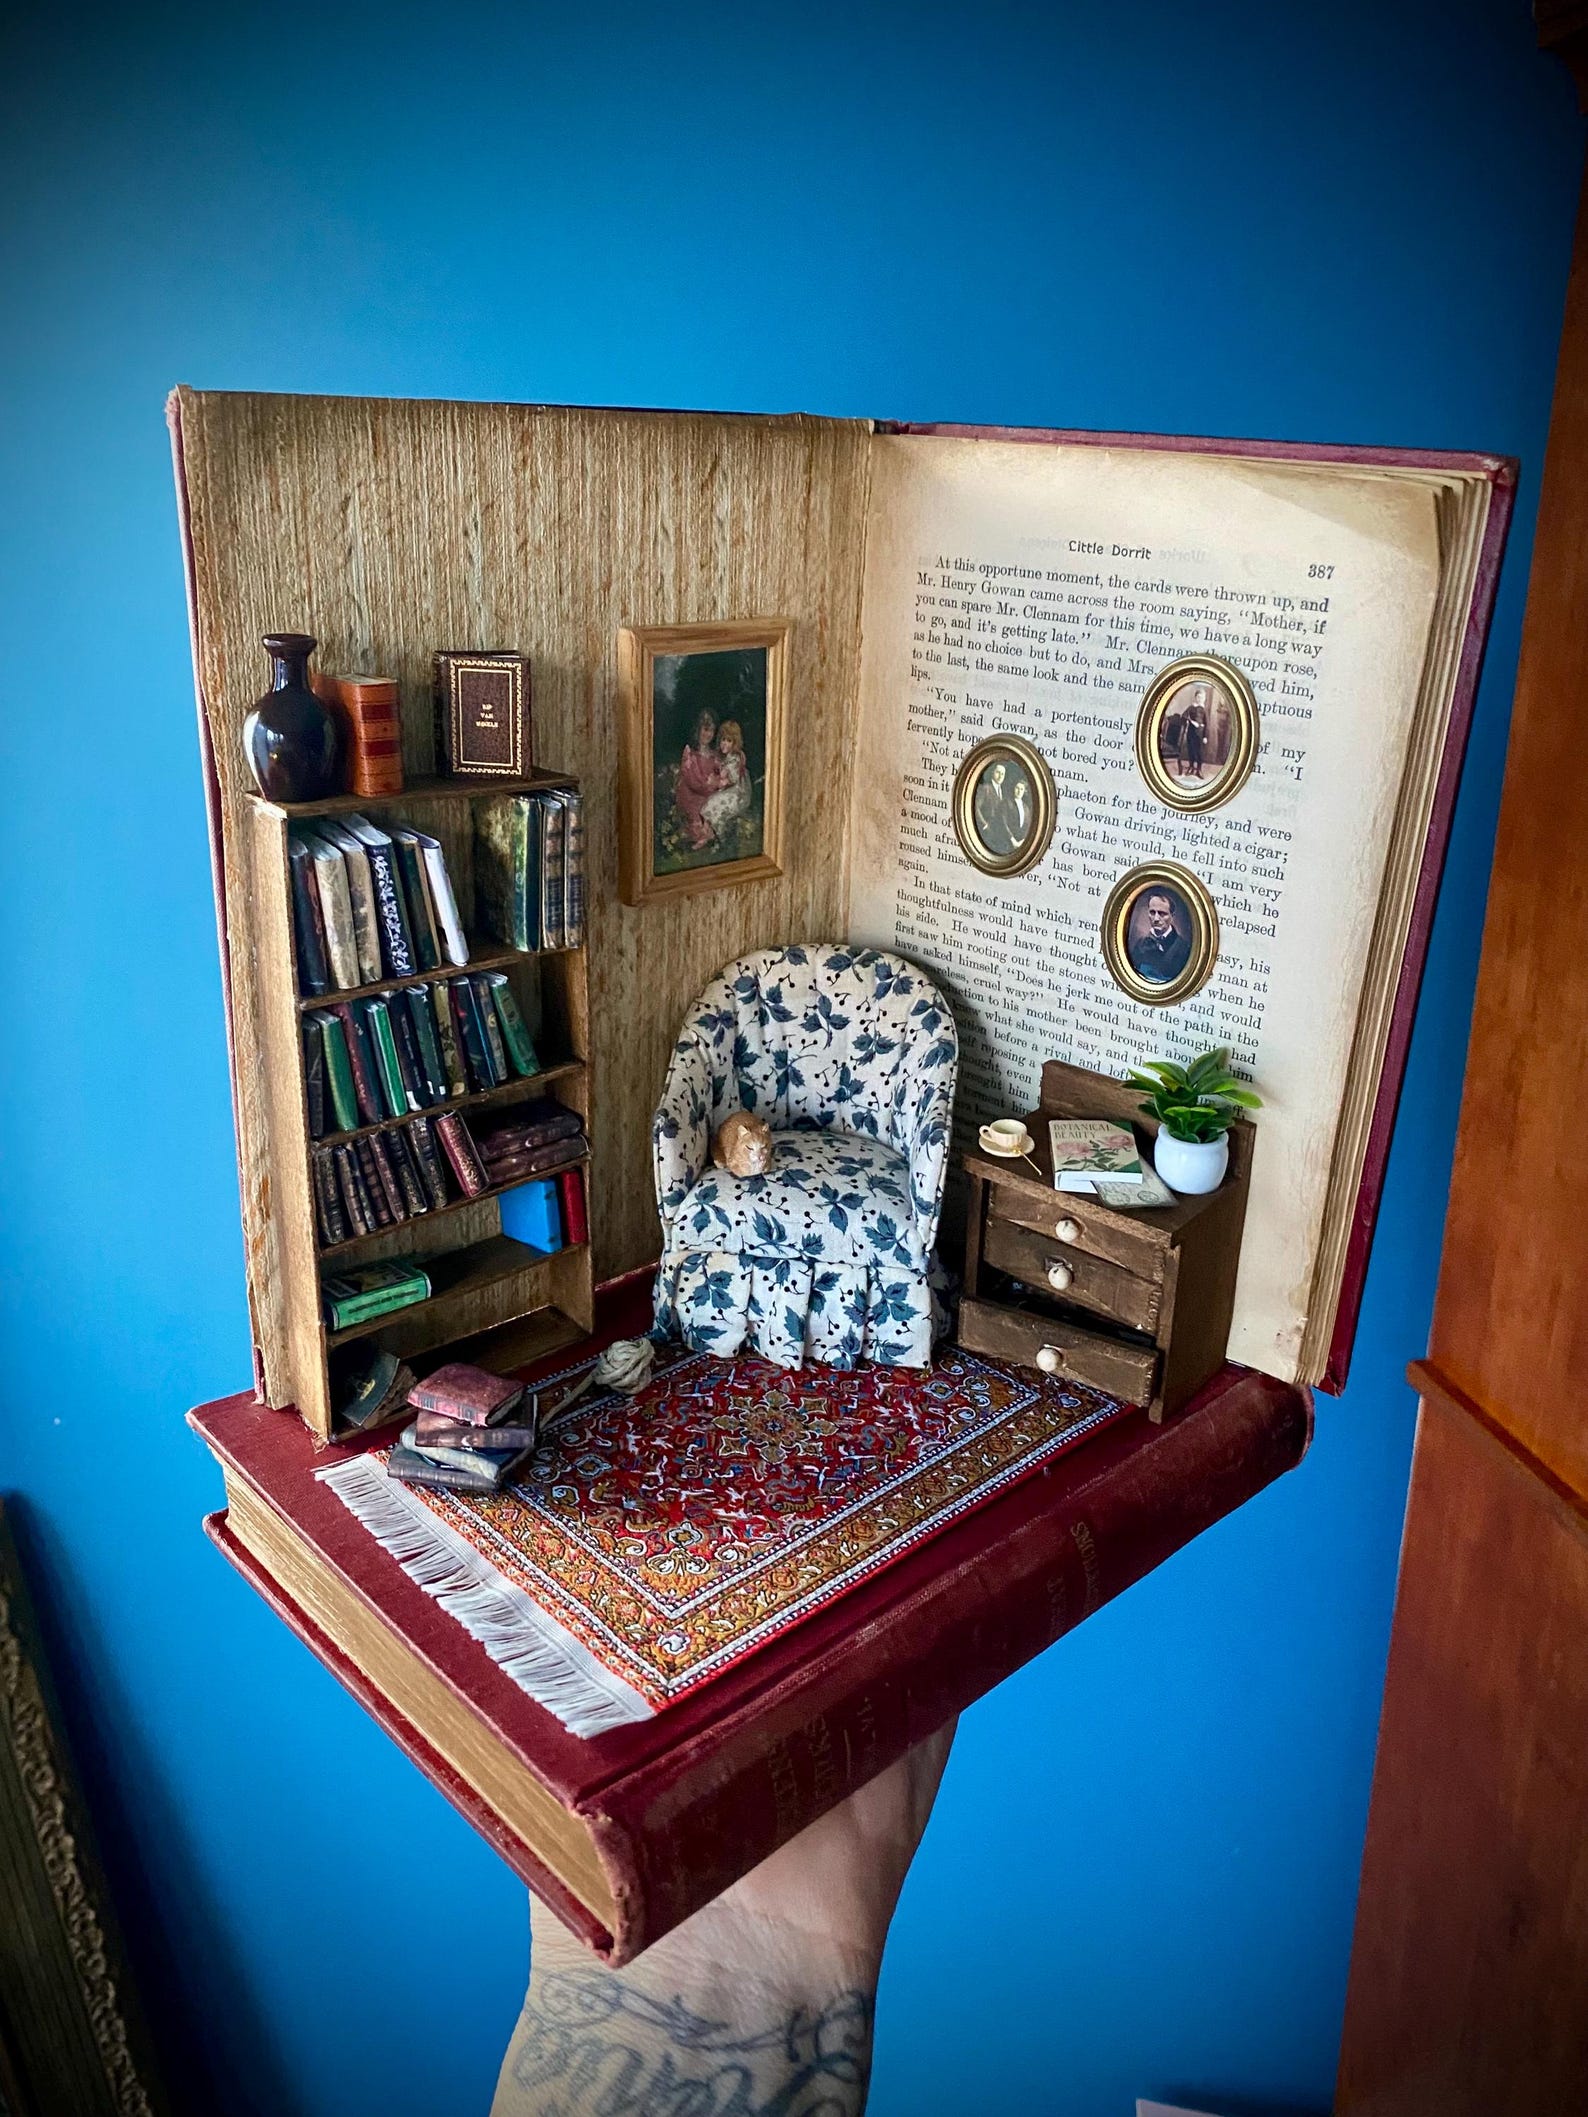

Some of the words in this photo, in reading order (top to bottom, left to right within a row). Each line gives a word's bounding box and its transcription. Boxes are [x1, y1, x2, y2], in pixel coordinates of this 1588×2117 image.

[1068, 540, 1103, 554] Little
[1111, 543, 1151, 560] Dorrit
[1307, 563, 1334, 579] 387
[917, 571, 935, 587] Mr.
[940, 574, 976, 595] Henry
[981, 579, 1025, 597] Gowan
[1029, 590, 1063, 602] came
[1067, 594, 1108, 607] across
[1113, 595, 1134, 610] the
[1139, 602, 1174, 618] room
[1179, 605, 1230, 625] saying,
[954, 557, 975, 572] this
[978, 564, 1041, 579] opportune
[1046, 571, 1103, 589] moment,
[1108, 574, 1129, 589] the
[1134, 579, 1171, 594] cards
[1175, 585, 1208, 598] were
[1214, 585, 1265, 605] thrown
[1299, 597, 1329, 612] and
[915, 594, 935, 606] you
[938, 597, 957, 608] can
[960, 600, 991, 614] spare
[995, 600, 1018, 617] Mr.
[1022, 604, 1079, 624] Clennam
[1084, 612, 1104, 627] for
[1109, 615, 1135, 631] this
[1139, 619, 1173, 639] time,
[1203, 626, 1239, 644] have
[1254, 632, 1287, 654] long
[1291, 642, 1322, 658] way
[950, 616, 971, 630] and
[1001, 624, 1047, 643] getting
[1104, 634, 1128, 651] Mr.
[1283, 662, 1317, 679] rose,
[910, 664, 930, 681] lips.
[925, 649, 941, 663] the
[946, 651, 969, 670] last,
[975, 657, 993, 671] the
[997, 664, 1029, 677] same
[1032, 664, 1059, 681] look
[1063, 672, 1087, 685] and
[1093, 674, 1113, 689] the
[1117, 681, 1146, 694] sam
[943, 632, 963, 648] had
[984, 639, 1022, 656] choice
[1029, 644, 1050, 660] but
[1096, 656, 1121, 670] and
[1126, 659, 1158, 676] Mrs.
[1280, 679, 1313, 700] him,
[960, 712, 983, 726] said
[991, 716, 1038, 737] Gowan,
[1065, 729, 1086, 744] the
[1093, 733, 1123, 749] door
[965, 692, 993, 709] have
[1002, 699, 1025, 715] had
[1050, 710, 1133, 735] portentously
[906, 718, 954, 742] fervently
[1037, 742, 1058, 758] not
[1062, 746, 1096, 765] bored
[1100, 754, 1135, 775] you?
[903, 774, 924, 786] soon
[1074, 806, 1119, 826] Gowan
[1124, 816, 1176, 841] driving,
[1181, 827, 1230, 849] lighted
[1244, 841, 1287, 864] cigar;
[921, 756, 948, 776] They
[1056, 784, 1107, 804] phaeton
[1111, 794, 1131, 809] for
[1136, 799, 1156, 814] the
[1224, 819, 1251, 833] and
[1257, 825, 1291, 841] were
[902, 787, 947, 809] Clennam
[1066, 825, 1097, 841] what
[1122, 838, 1165, 858] would,
[1191, 850, 1214, 865] fell
[1218, 855, 1246, 872] into
[1251, 865, 1284, 880] such
[910, 808, 937, 824] mood
[1060, 841, 1105, 862] Gowan
[1113, 852, 1140, 869] said
[1249, 884, 1282, 902] very
[898, 857, 928, 873] again.
[899, 841, 931, 857] roused
[1219, 913, 1276, 937] relapsed
[900, 824, 927, 839] much
[1052, 856, 1073, 872] has
[1082, 863, 1116, 882] bored
[1210, 892, 1253, 913] which
[895, 903, 910, 918] his
[915, 911, 938, 926] side.
[972, 927, 1006, 944] would
[1013, 934, 1042, 953] have
[1049, 945, 1097, 967] thought
[1207, 987, 1243, 1005] when
[897, 888, 974, 918] thoughtfulness
[978, 912, 1012, 928] would
[1019, 918, 1047, 936] have
[1054, 928, 1094, 949] turned
[1218, 972, 1248, 988] man
[929, 880, 951, 895] that
[954, 888, 982, 903] state
[1001, 900, 1031, 915] mind
[1035, 907, 1072, 925] which
[1249, 957, 1270, 974] his
[894, 934, 918, 952] have
[922, 946, 952, 962] asked
[958, 953, 1001, 978] himself,
[1065, 983, 1090, 1000] jerk
[1116, 1001, 1137, 1014] out
[1159, 1010, 1179, 1025] the
[1183, 1019, 1213, 1035] path
[1237, 1031, 1258, 1047] the
[895, 919, 914, 935] first
[918, 929, 938, 941] saw
[942, 932, 962, 949] him
[966, 943, 1007, 963] rooting
[1010, 955, 1029, 967] out
[1036, 959, 1054, 973] the
[1058, 967, 1095, 984] stones
[1189, 1003, 1214, 1017] and
[1220, 1011, 1261, 1030] would
[973, 977, 1000, 991] cruel
[1082, 1007, 1118, 1025] would
[1127, 1017, 1157, 1036] have
[1230, 1047, 1256, 1065] had
[984, 1010, 1012, 1026] what
[1015, 1019, 1034, 1033] she
[1038, 1027, 1072, 1046] would
[1076, 1039, 1100, 1056] say,
[1105, 1049, 1128, 1062] and
[993, 1026, 1027, 1048] before
[1044, 1045, 1071, 1062] rival
[1078, 1058, 1101, 1071] and
[1002, 997, 1019, 1012] his
[1025, 1007, 1067, 1025] mother
[1075, 1018, 1101, 1037] been
[1110, 1028, 1158, 1054] brought
[1053, 1123, 1111, 1132] BOTANICAL
[1054, 1131, 1096, 1139] BEAUTY
